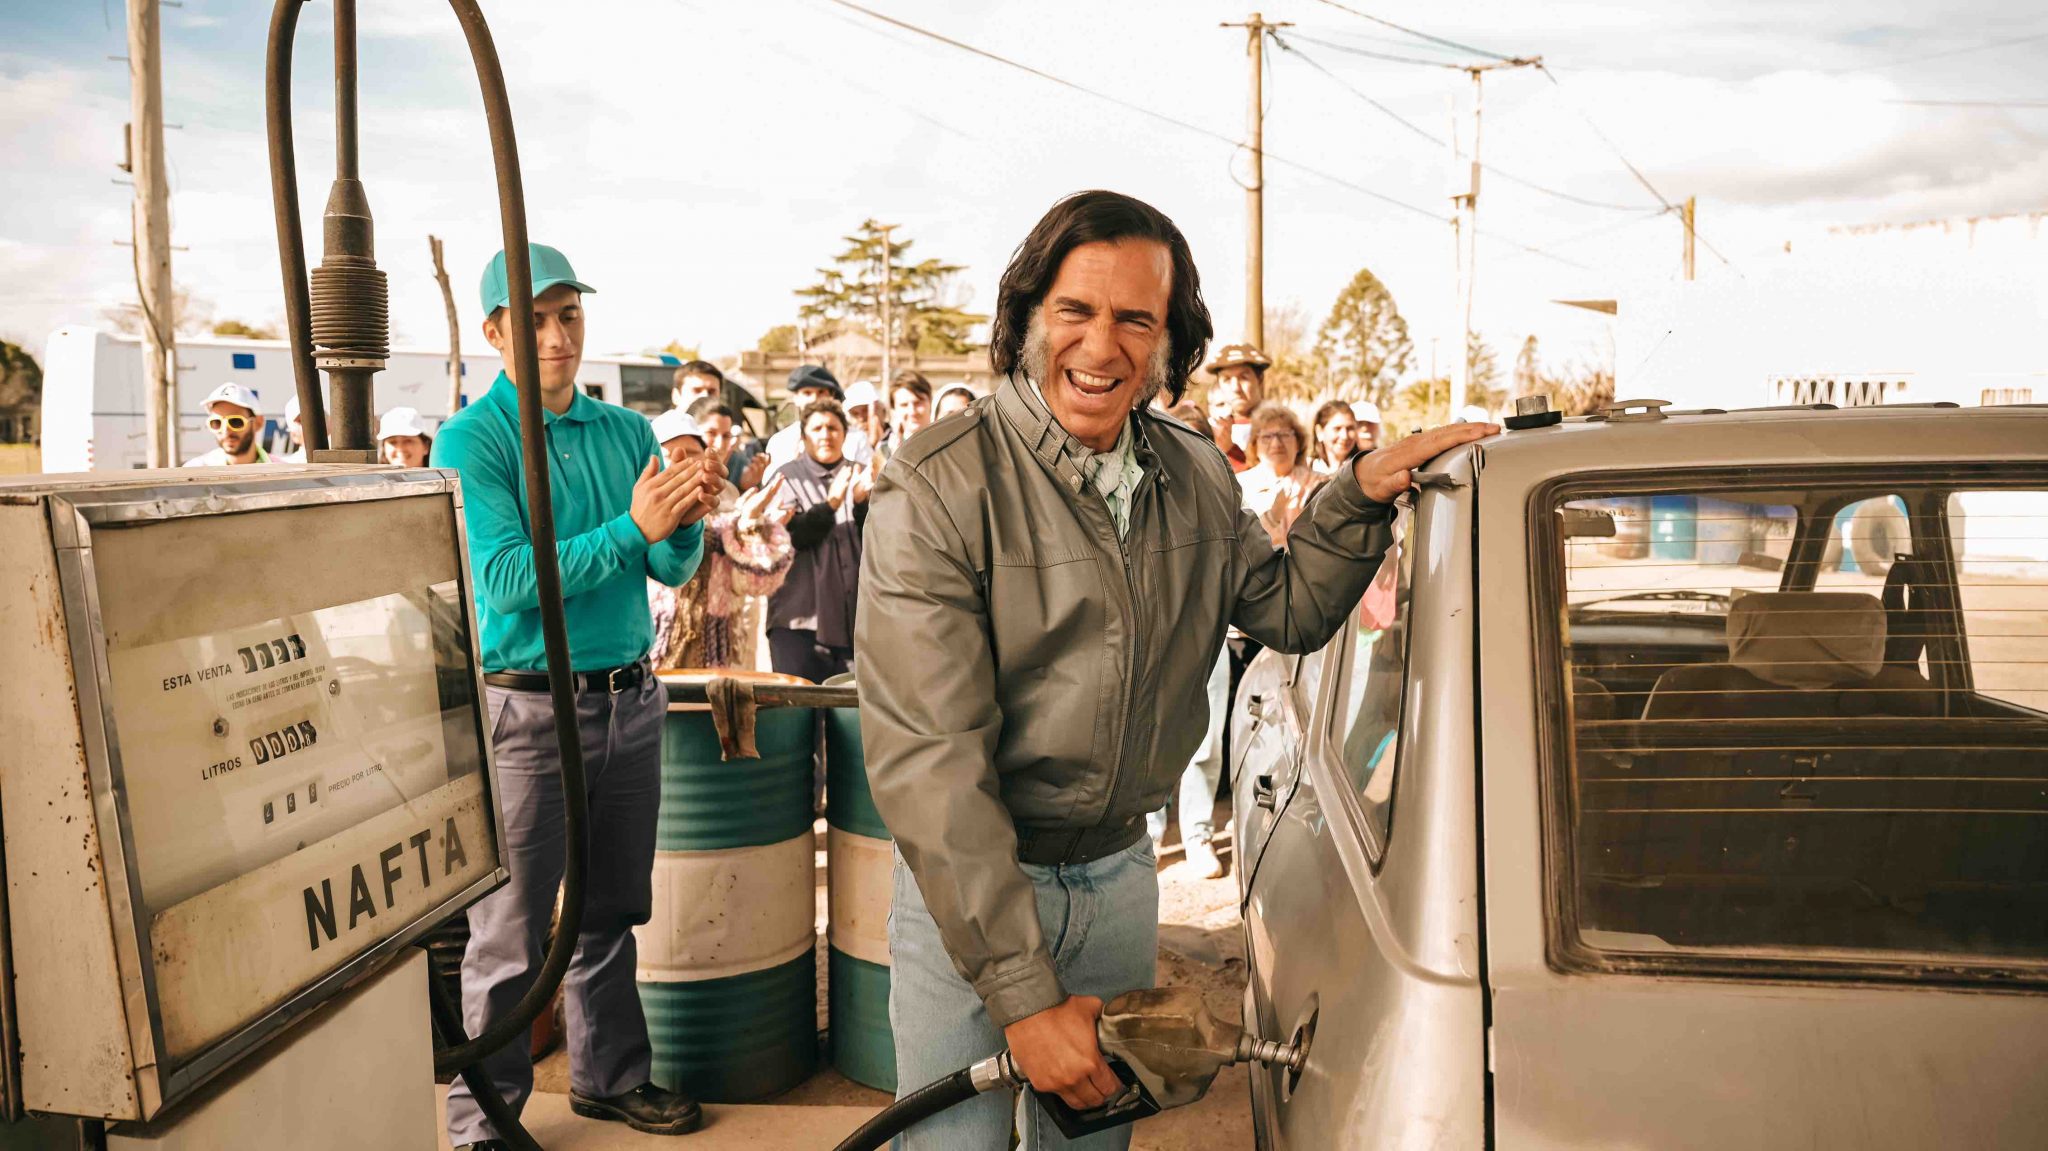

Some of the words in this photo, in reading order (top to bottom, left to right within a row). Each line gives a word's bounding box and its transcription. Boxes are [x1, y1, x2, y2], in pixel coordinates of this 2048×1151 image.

[163, 673, 192, 691] ESTA
[197, 663, 233, 682] VENTA
[202, 757, 242, 781] LITROS
[328, 777, 351, 793] PRECIO
[352, 771, 364, 783] POR
[366, 763, 383, 777] LITRO
[303, 816, 468, 952] NAFTA
